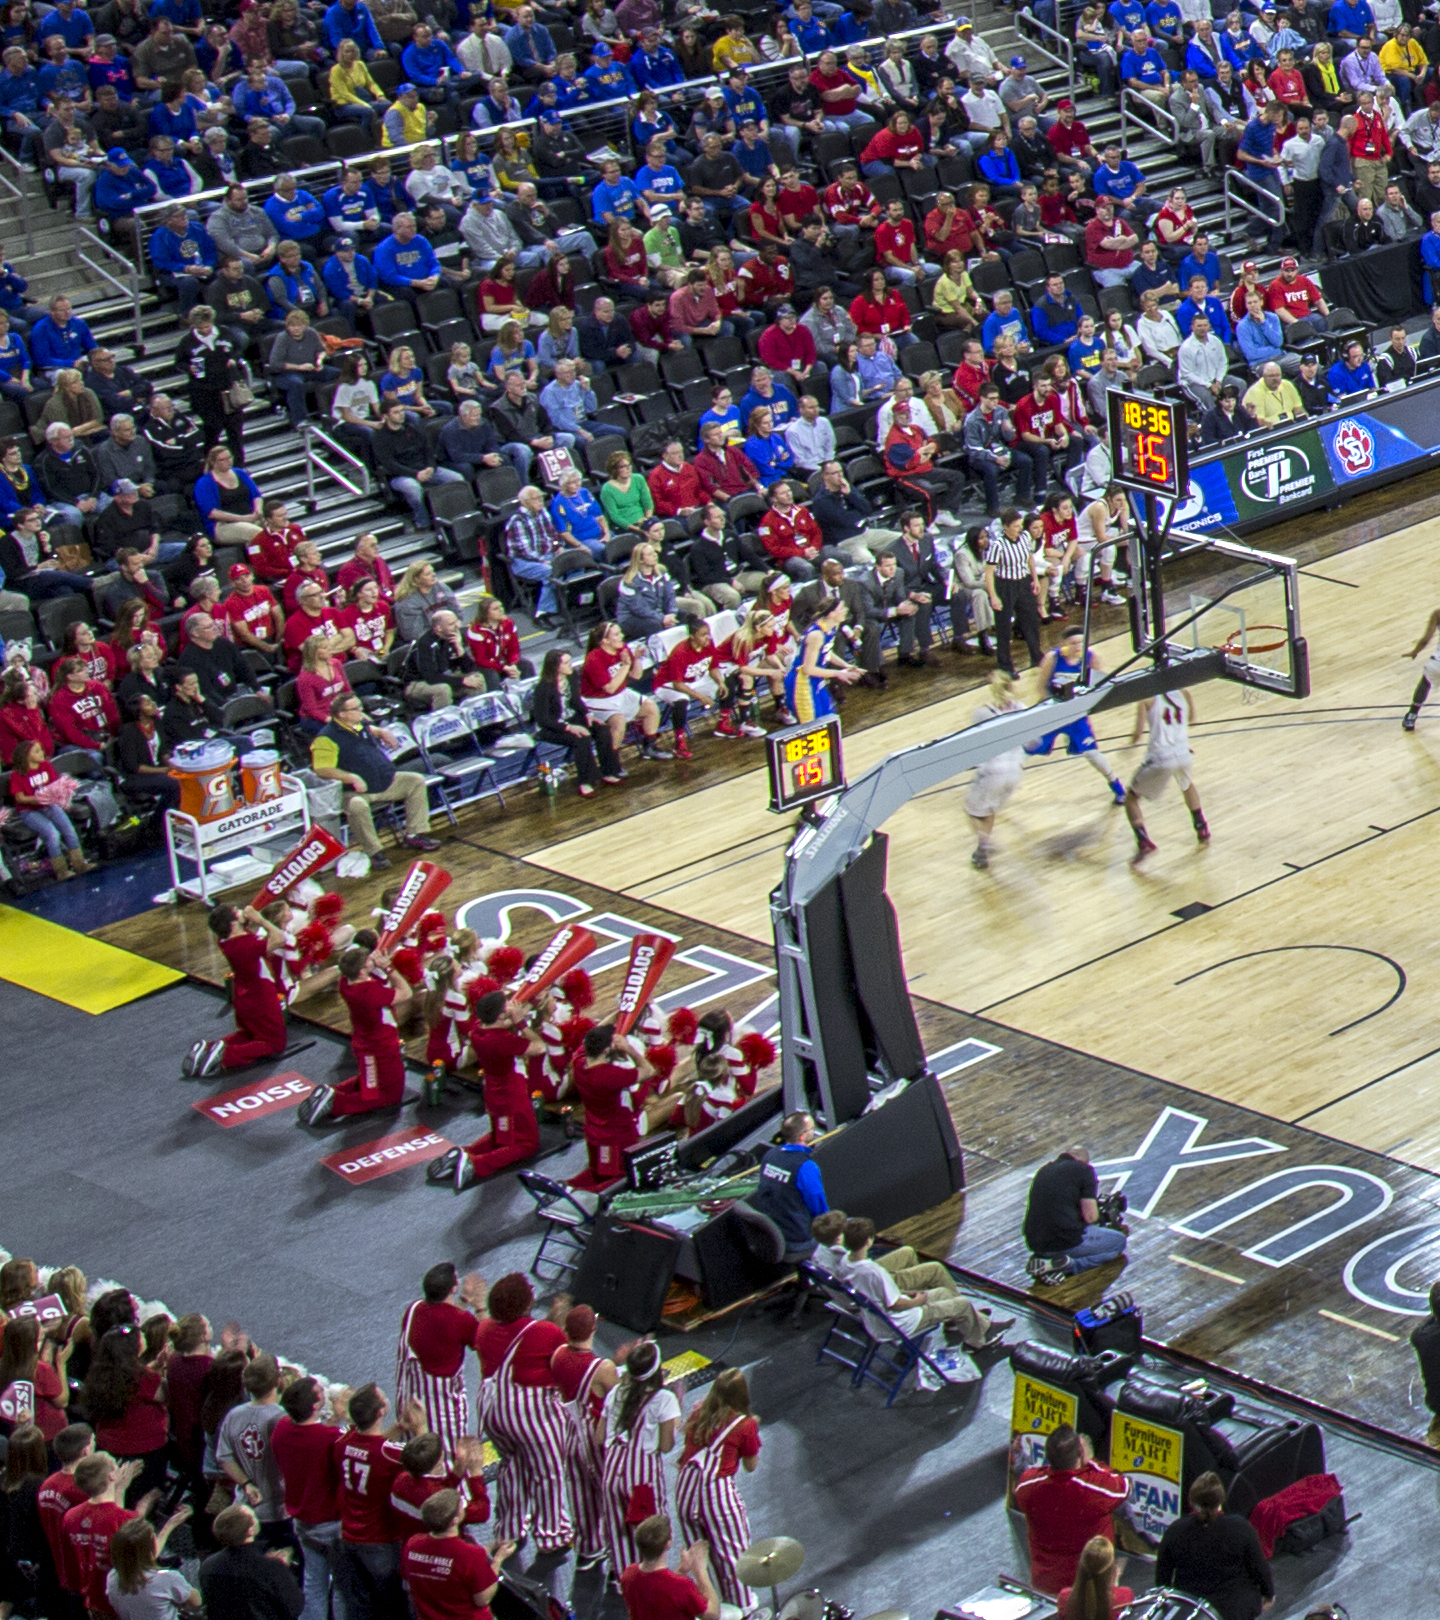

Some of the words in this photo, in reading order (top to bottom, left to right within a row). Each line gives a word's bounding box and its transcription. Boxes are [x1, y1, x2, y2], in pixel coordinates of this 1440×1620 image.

[1123, 402, 1171, 436] 18:36
[1136, 433, 1169, 482] 15
[1247, 447, 1265, 461] First
[1247, 450, 1286, 471] PREMIER
[1248, 467, 1267, 480] Bank
[1279, 474, 1316, 494] PREMIER
[1278, 485, 1313, 505] Bankcard
[785, 729, 830, 762] 18:36
[796, 756, 824, 788] 15
[217, 802, 284, 834] GATORADE
[804, 806, 849, 860] SPALDING
[266, 839, 327, 896] COYOTES
[384, 865, 429, 933] COYOTES
[528, 928, 574, 984] COYOTES
[619, 944, 657, 1014] COYOTES
[210, 1076, 312, 1120] NOISE
[338, 1129, 446, 1177] DEFENSE
[1024, 1382, 1068, 1411] Furniture
[1024, 1395, 1066, 1424] MART
[1123, 1420, 1173, 1451] Furniture
[1124, 1437, 1171, 1464] MART
[341, 1459, 372, 1496] 17
[1134, 1480, 1179, 1517] FAN
